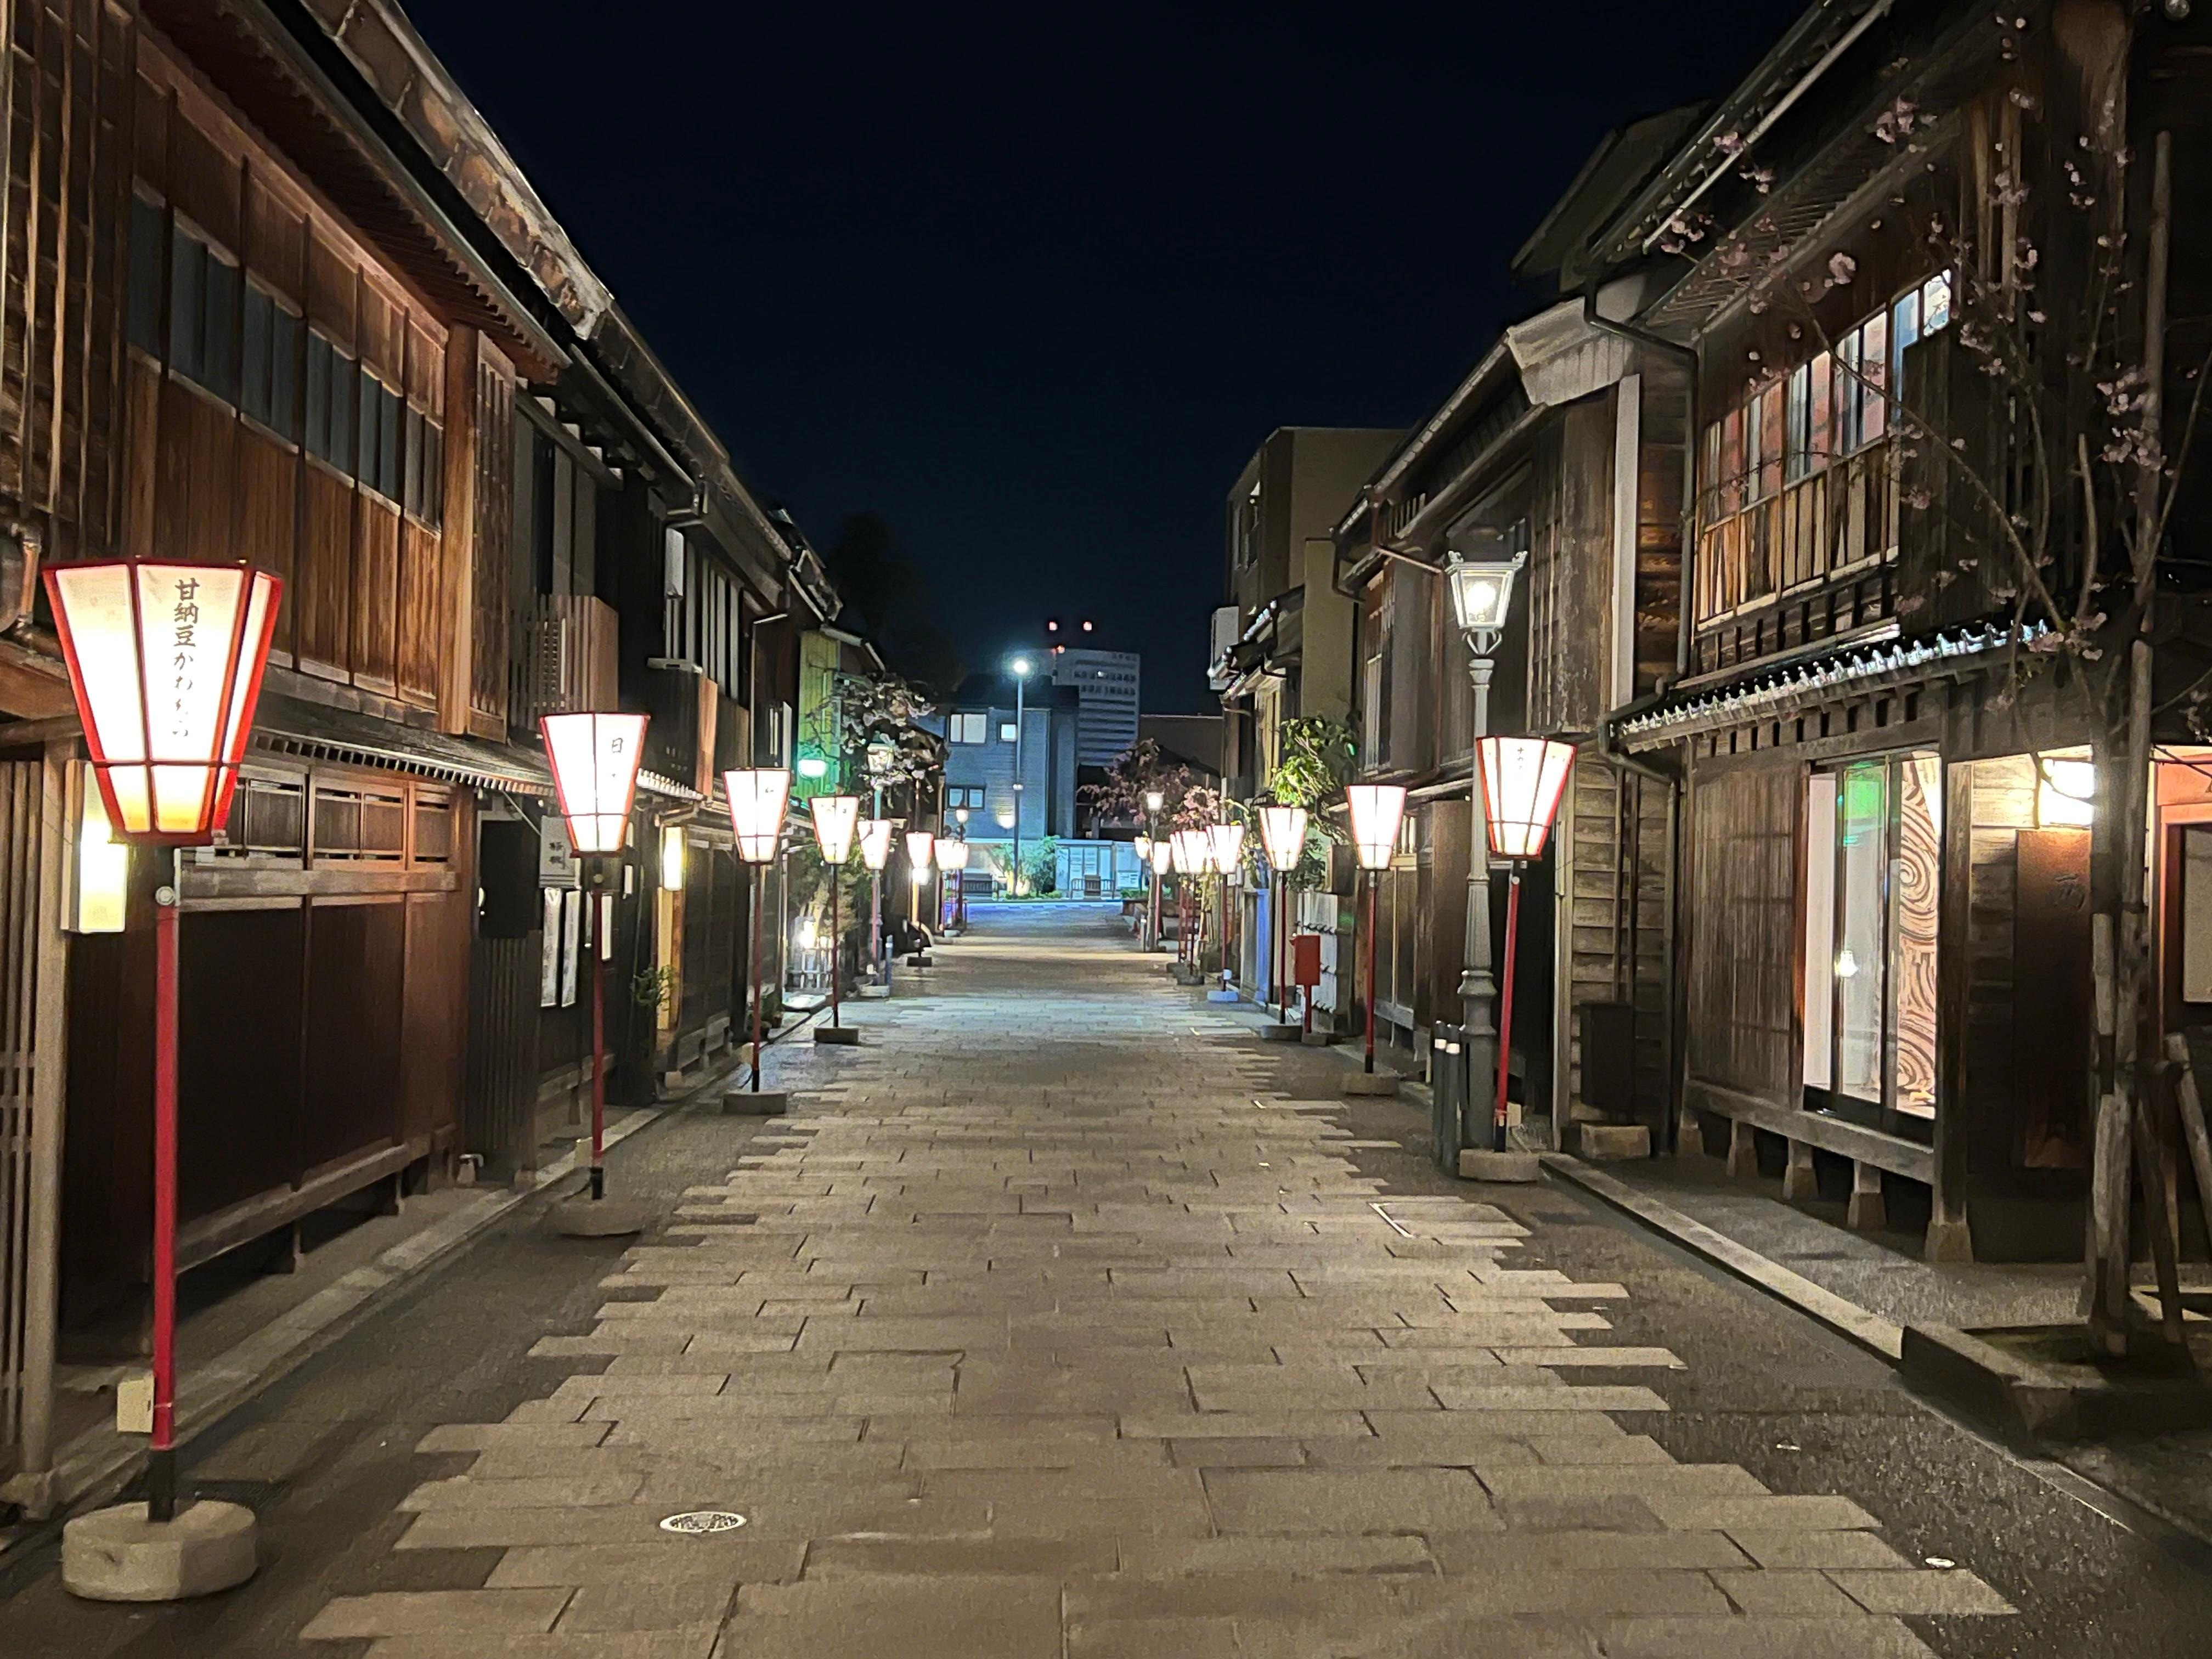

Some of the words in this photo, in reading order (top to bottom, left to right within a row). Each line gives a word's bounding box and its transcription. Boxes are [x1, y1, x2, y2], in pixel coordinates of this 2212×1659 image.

[172, 578, 200, 737] 甘納豆かわ
